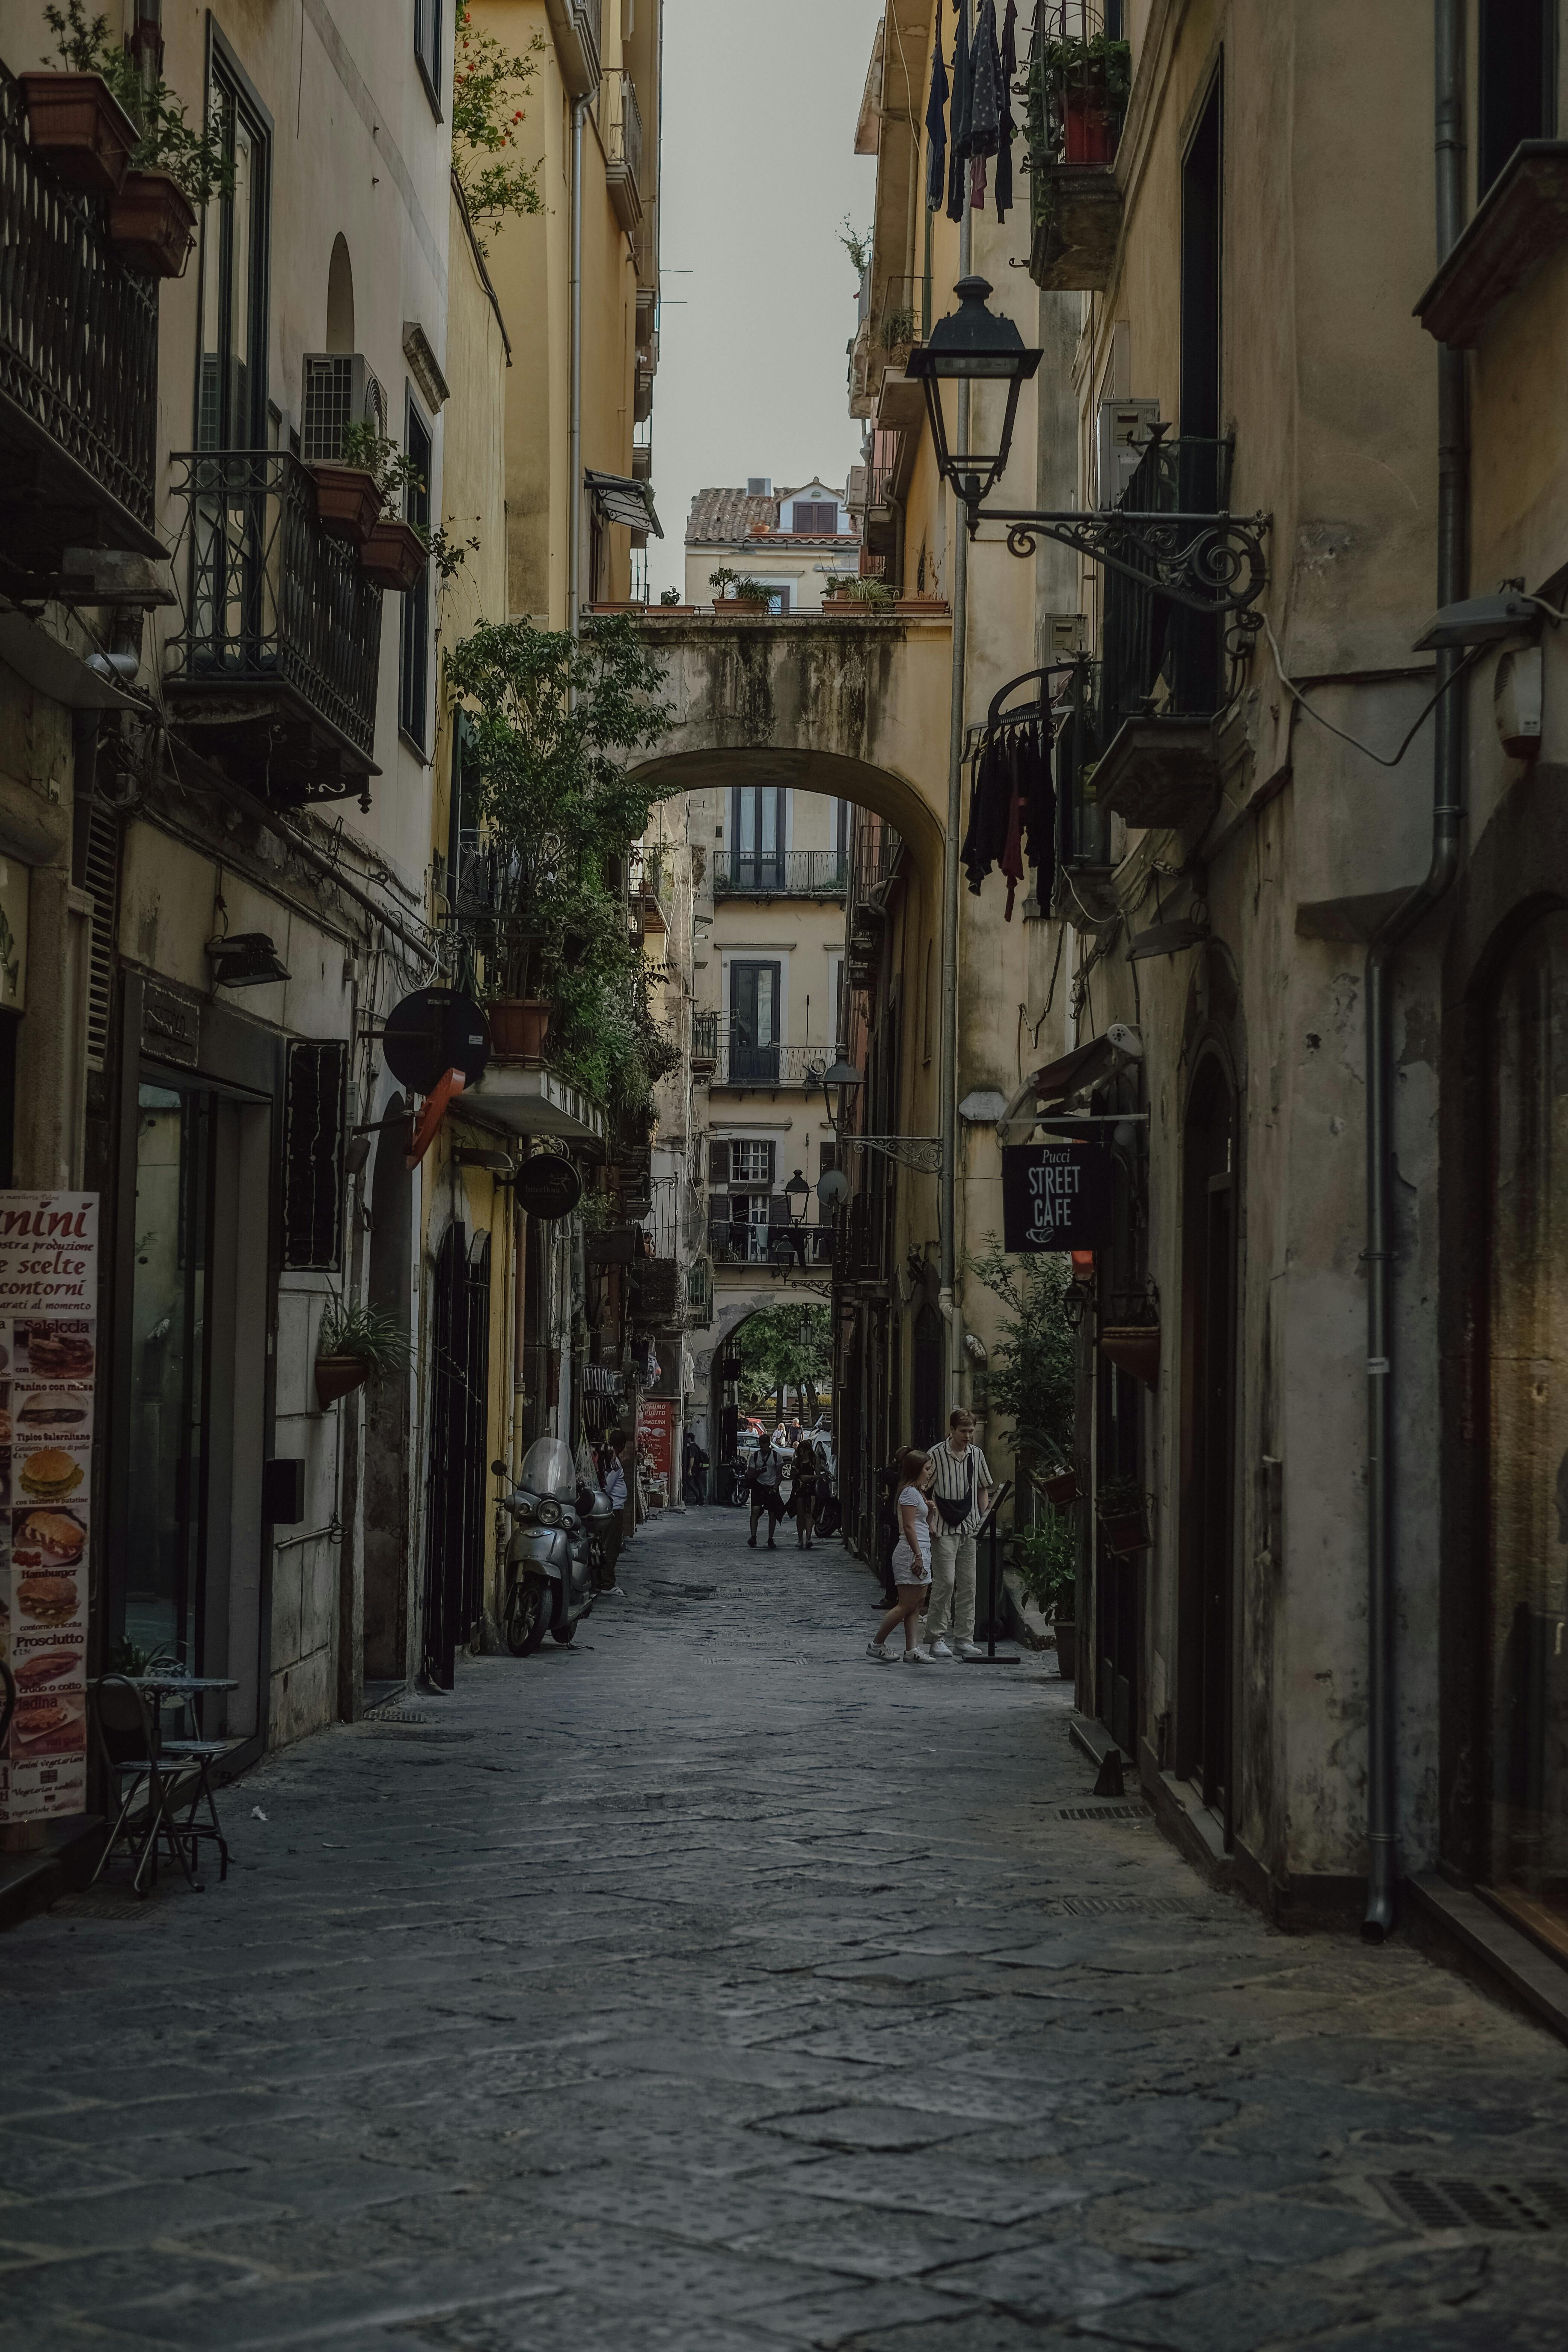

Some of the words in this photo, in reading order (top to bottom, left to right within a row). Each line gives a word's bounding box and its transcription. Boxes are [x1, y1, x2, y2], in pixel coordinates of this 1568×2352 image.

[1042, 1148, 1070, 1164] Pucci
[1028, 1166, 1081, 1195] STREET
[0, 1201, 94, 1238] nini
[1034, 1199, 1072, 1227] CAFE
[33, 1239, 94, 1253] produzione
[17, 1251, 86, 1275] scelte
[0, 1280, 87, 1296] contorni
[31, 1298, 42, 1310] al
[46, 1302, 91, 1311] momento
[24, 1320, 90, 1333] Salsiccia
[15, 1382, 47, 1391] Panino
[17, 1433, 42, 1442] Tipico
[44, 1433, 90, 1441] Salernitano
[22, 1568, 78, 1579] Hamburger
[16, 1633, 84, 1648] Prosciutto
[20, 1684, 47, 1694] crudo
[63, 1735, 83, 1747] gusti
[13, 1759, 39, 1770] Panini
[41, 1755, 85, 1768] vegetariani
[12, 1786, 52, 1798] Vegetarian
